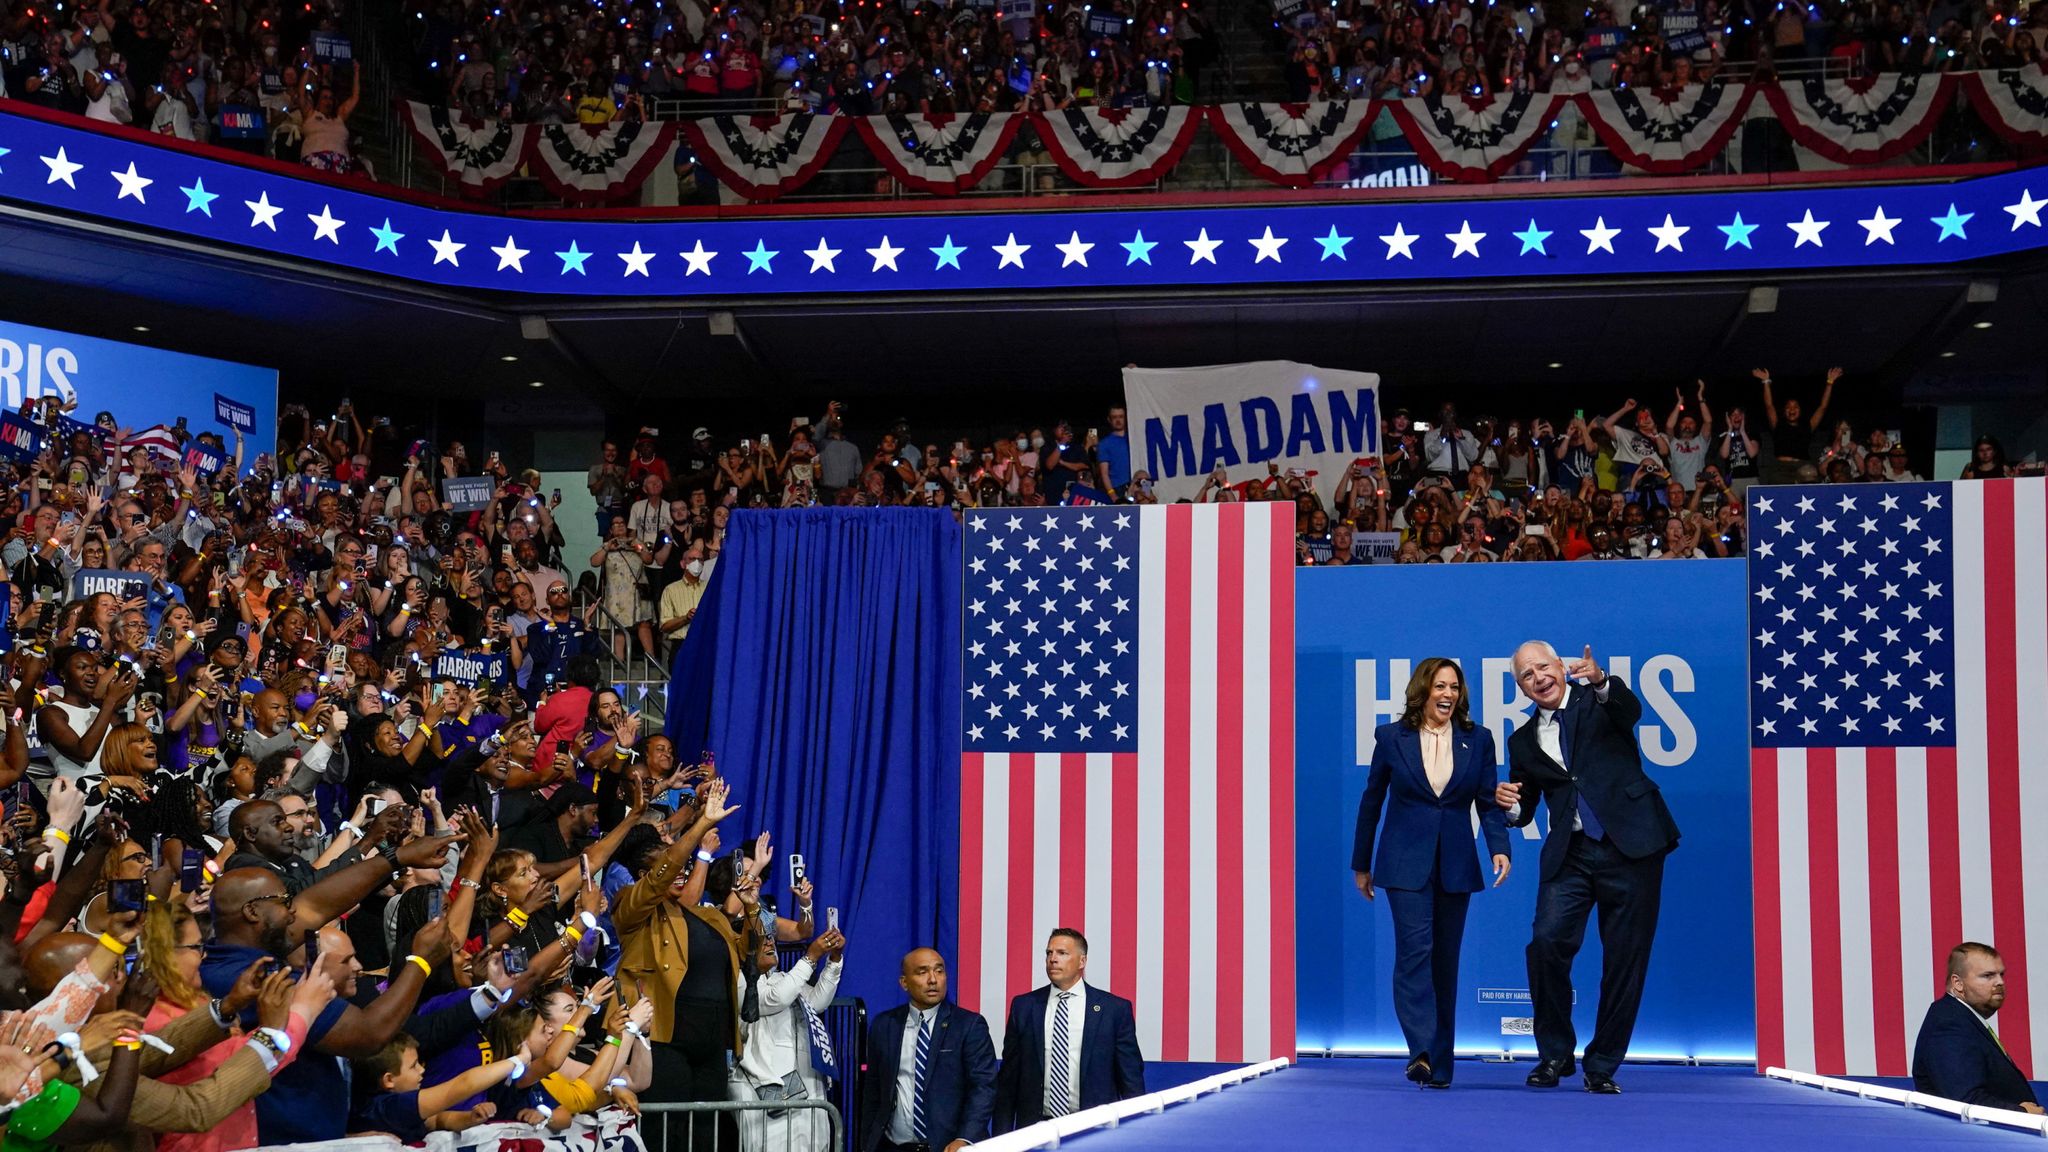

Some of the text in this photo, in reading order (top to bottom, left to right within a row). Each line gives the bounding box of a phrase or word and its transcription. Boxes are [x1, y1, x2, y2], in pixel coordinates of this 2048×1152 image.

[1663, 16, 1698, 29] HARRIS
[315, 41, 351, 59] WE WIN
[218, 404, 251, 427] WE WIN
[1145, 388, 1377, 480] MADAM
[448, 488, 490, 503] WE WIN
[1312, 548, 1333, 563] WIN
[1355, 544, 1394, 558] WE WIN
[437, 656, 484, 681] HARRIS
